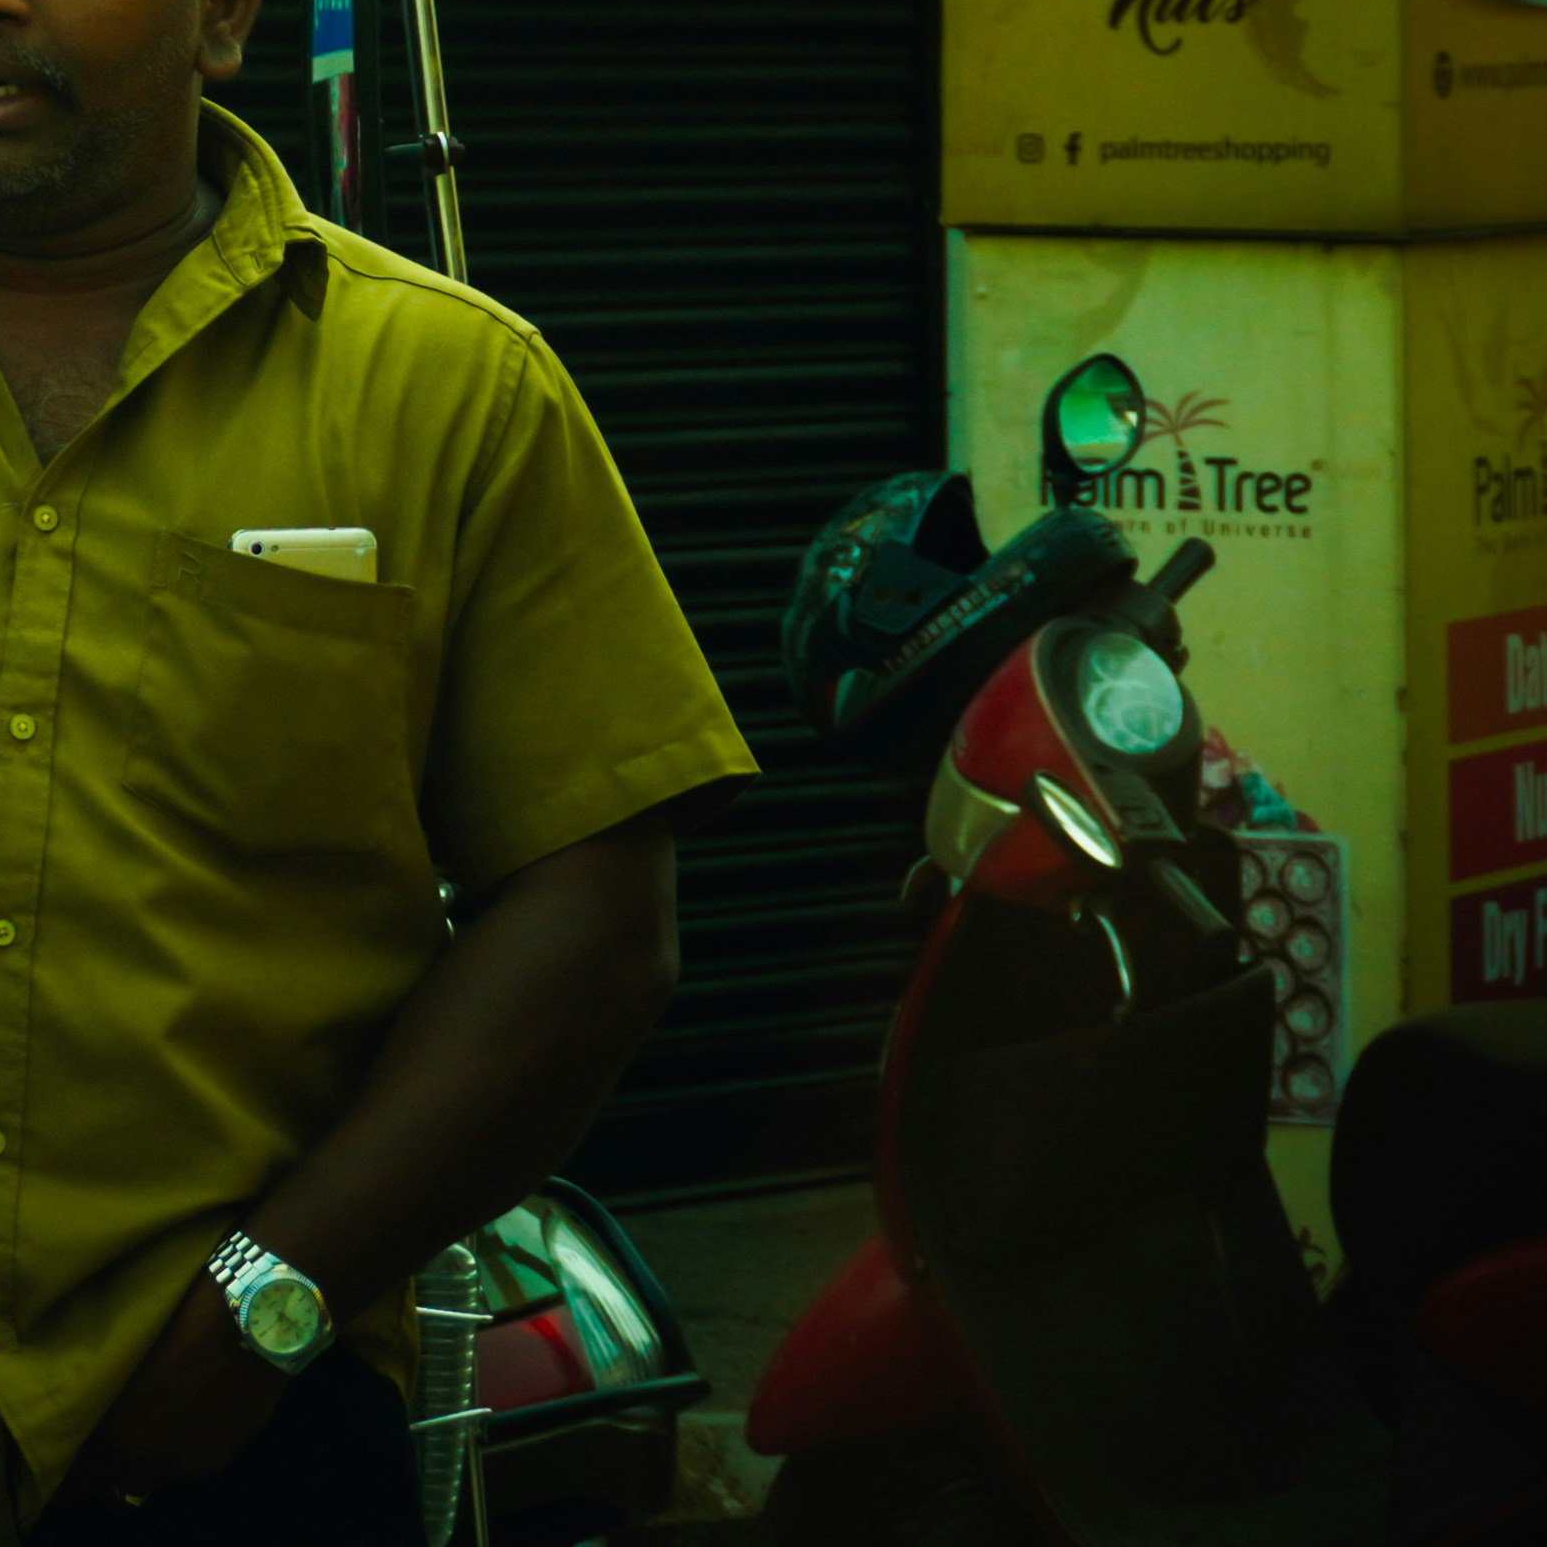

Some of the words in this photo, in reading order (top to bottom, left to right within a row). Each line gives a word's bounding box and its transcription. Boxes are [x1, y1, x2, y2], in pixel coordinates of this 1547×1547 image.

[1099, 135, 1332, 168] palmtreeshopping
[1205, 457, 1313, 513] Tree
[1474, 452, 1537, 525] Palm
[1202, 519, 1313, 539] Universe
[1482, 900, 1529, 988] Dry
